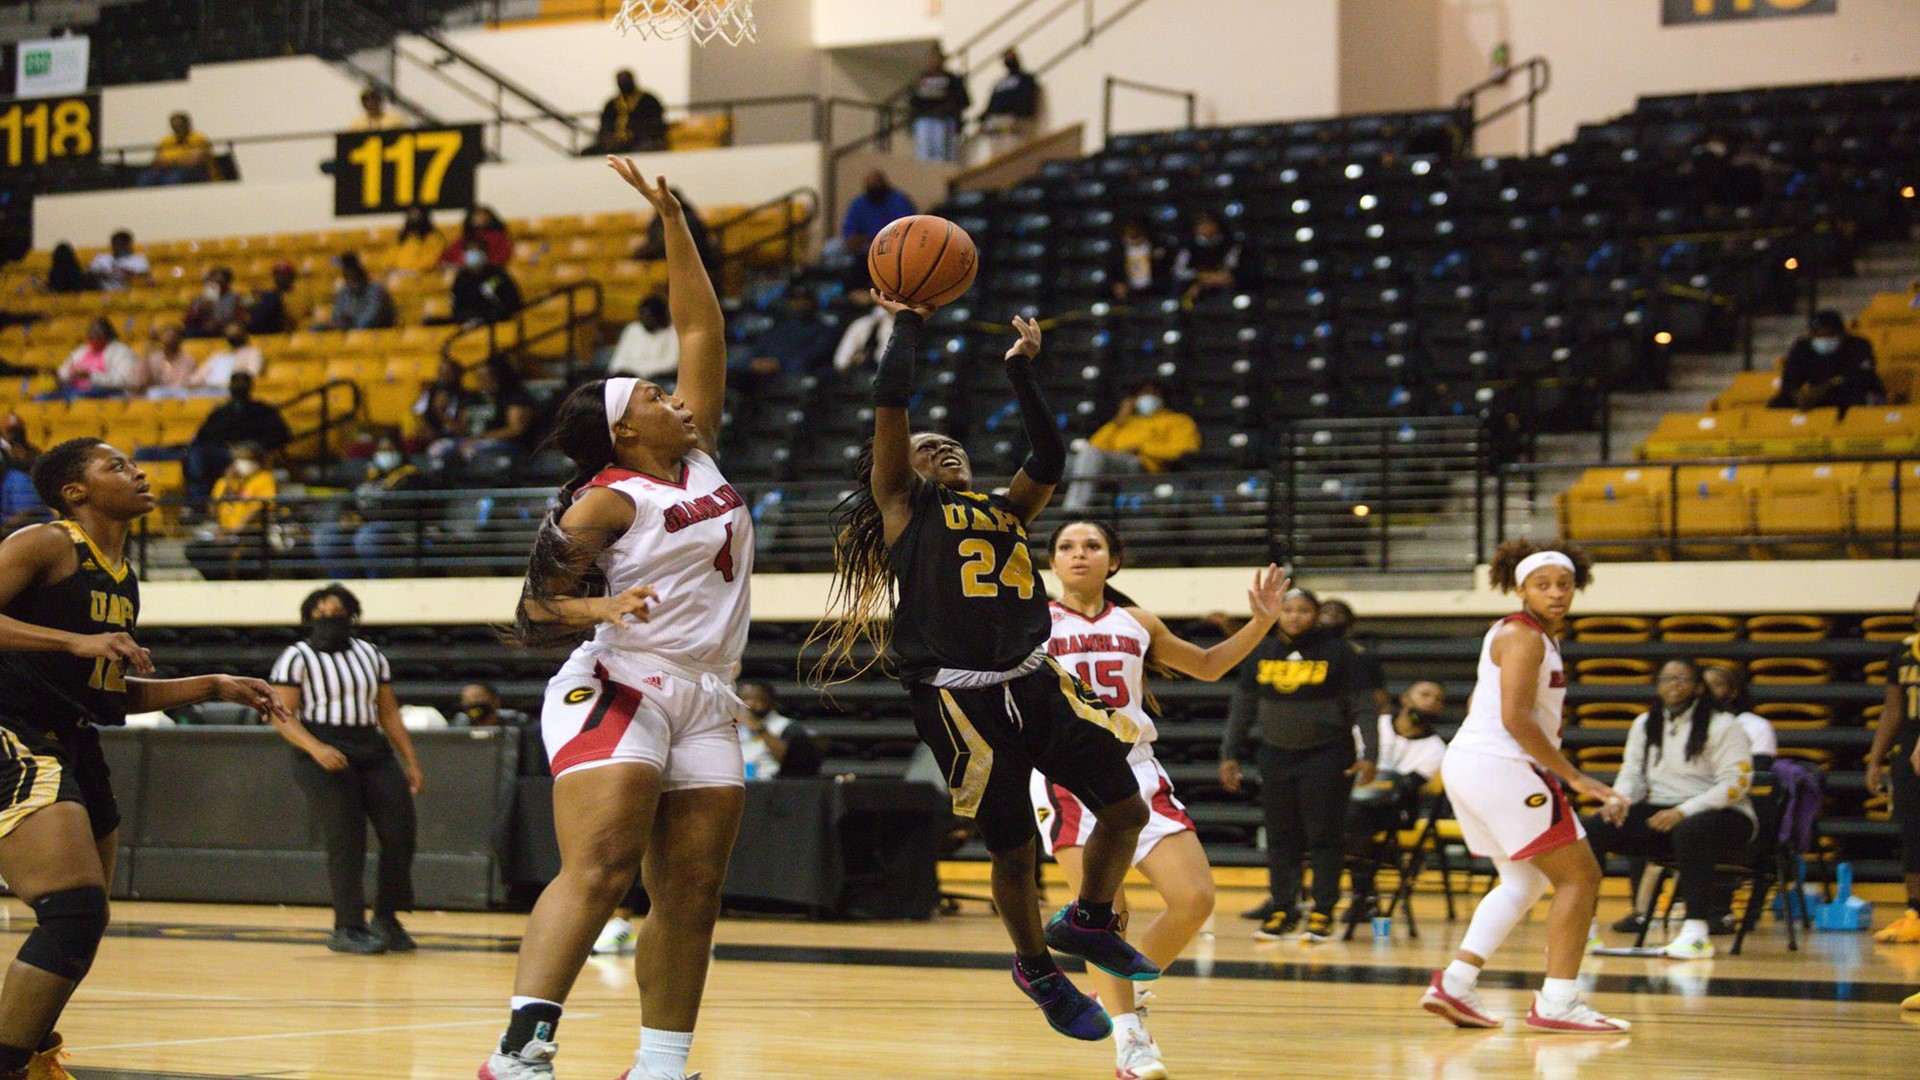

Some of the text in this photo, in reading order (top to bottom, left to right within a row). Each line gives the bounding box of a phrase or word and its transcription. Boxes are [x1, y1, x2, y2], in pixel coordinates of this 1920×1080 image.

[0, 100, 93, 166] 118
[349, 130, 463, 208] 117
[941, 503, 1028, 540] UAP
[713, 522, 734, 582] 4
[958, 538, 1035, 599] 24
[91, 589, 135, 629] UAP
[1075, 660, 1130, 708] 15
